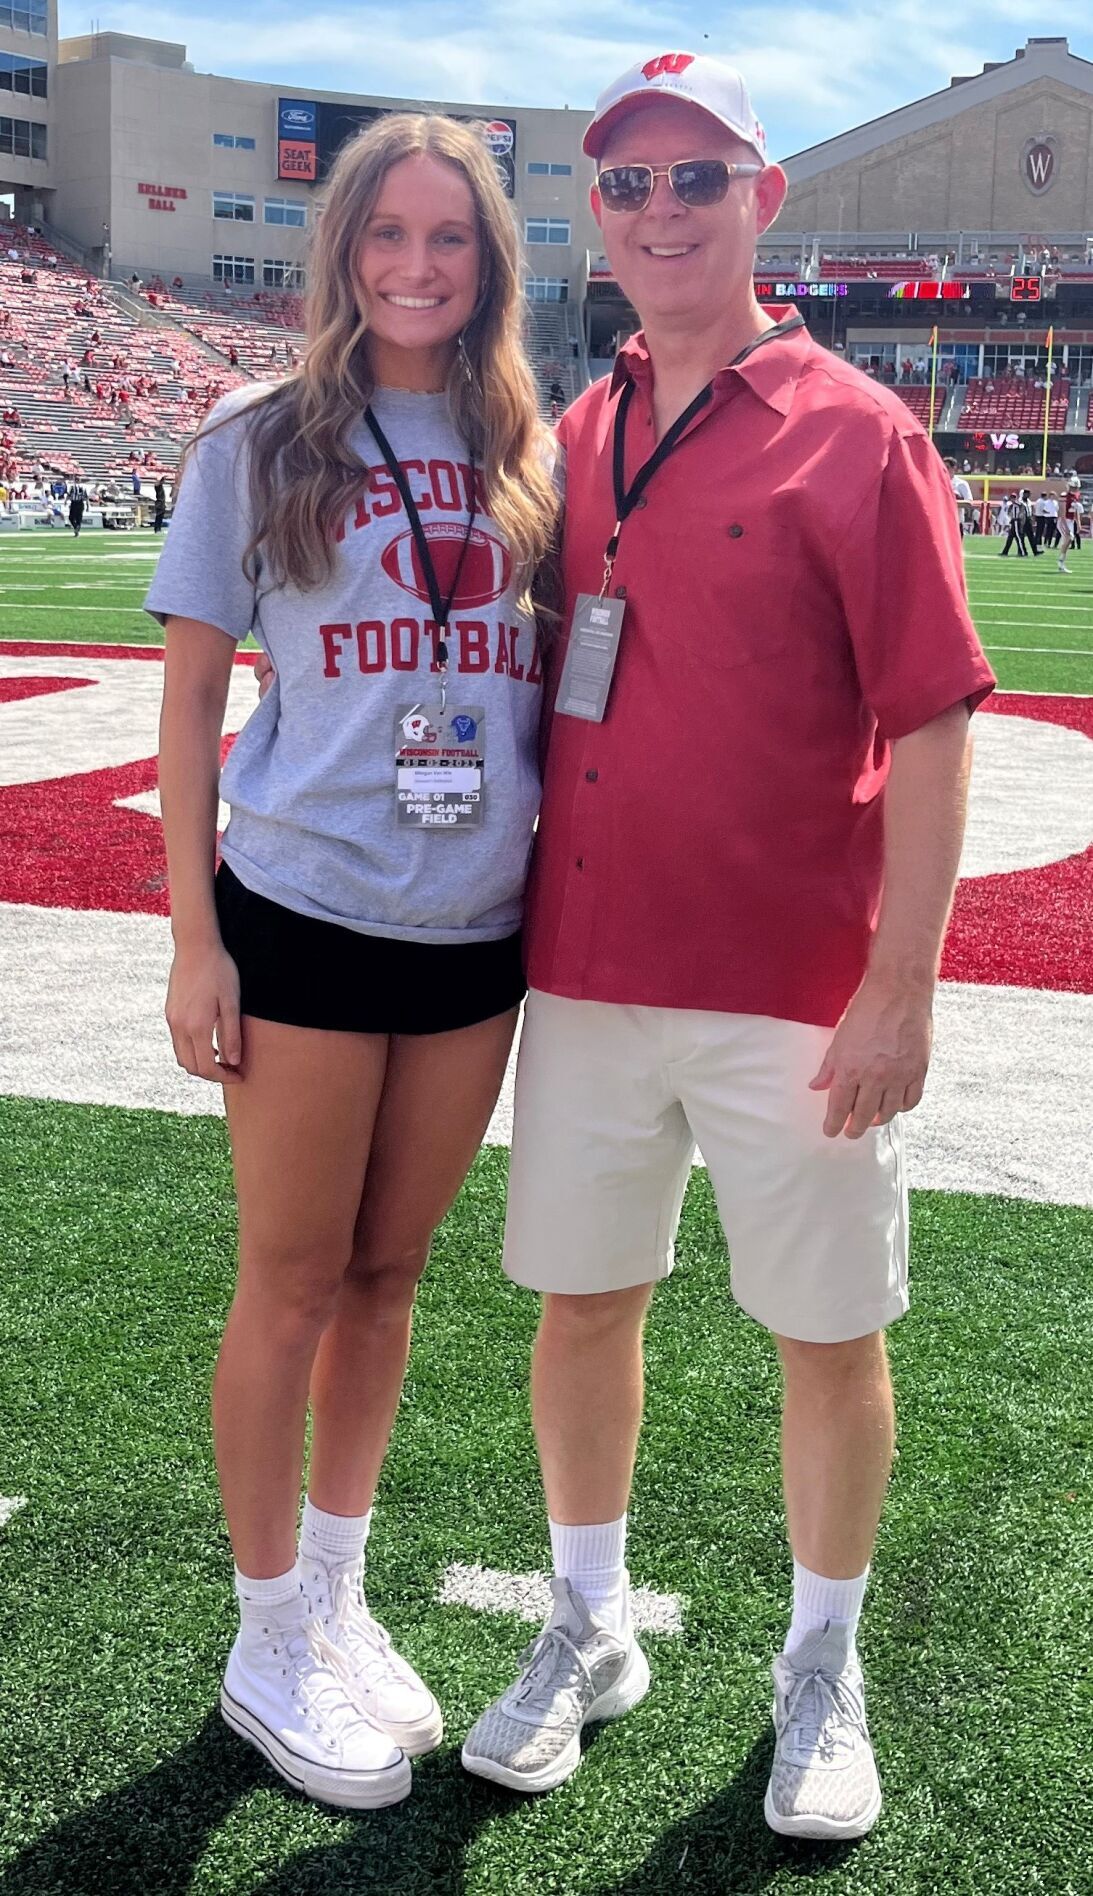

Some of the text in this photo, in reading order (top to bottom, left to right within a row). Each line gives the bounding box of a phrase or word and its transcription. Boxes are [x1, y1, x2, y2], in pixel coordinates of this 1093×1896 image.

[641, 53, 695, 81] W
[284, 148, 311, 161] SEAT
[281, 160, 312, 174] GEEK
[1028, 151, 1052, 184] W
[148, 197, 177, 213] HALL
[774, 283, 849, 297] BADGERS
[1012, 278, 1039, 299] 25
[989, 432, 1026, 450] VS.
[335, 459, 493, 544] ISCON
[319, 617, 543, 686] FOOTBALL
[400, 749, 440, 757] WISCONSIN
[442, 749, 479, 757] FOOTBALL
[398, 792, 430, 801] GAME
[433, 793, 445, 802] 01
[406, 803, 473, 814] PRE-GAME
[421, 813, 458, 824] FIELD
